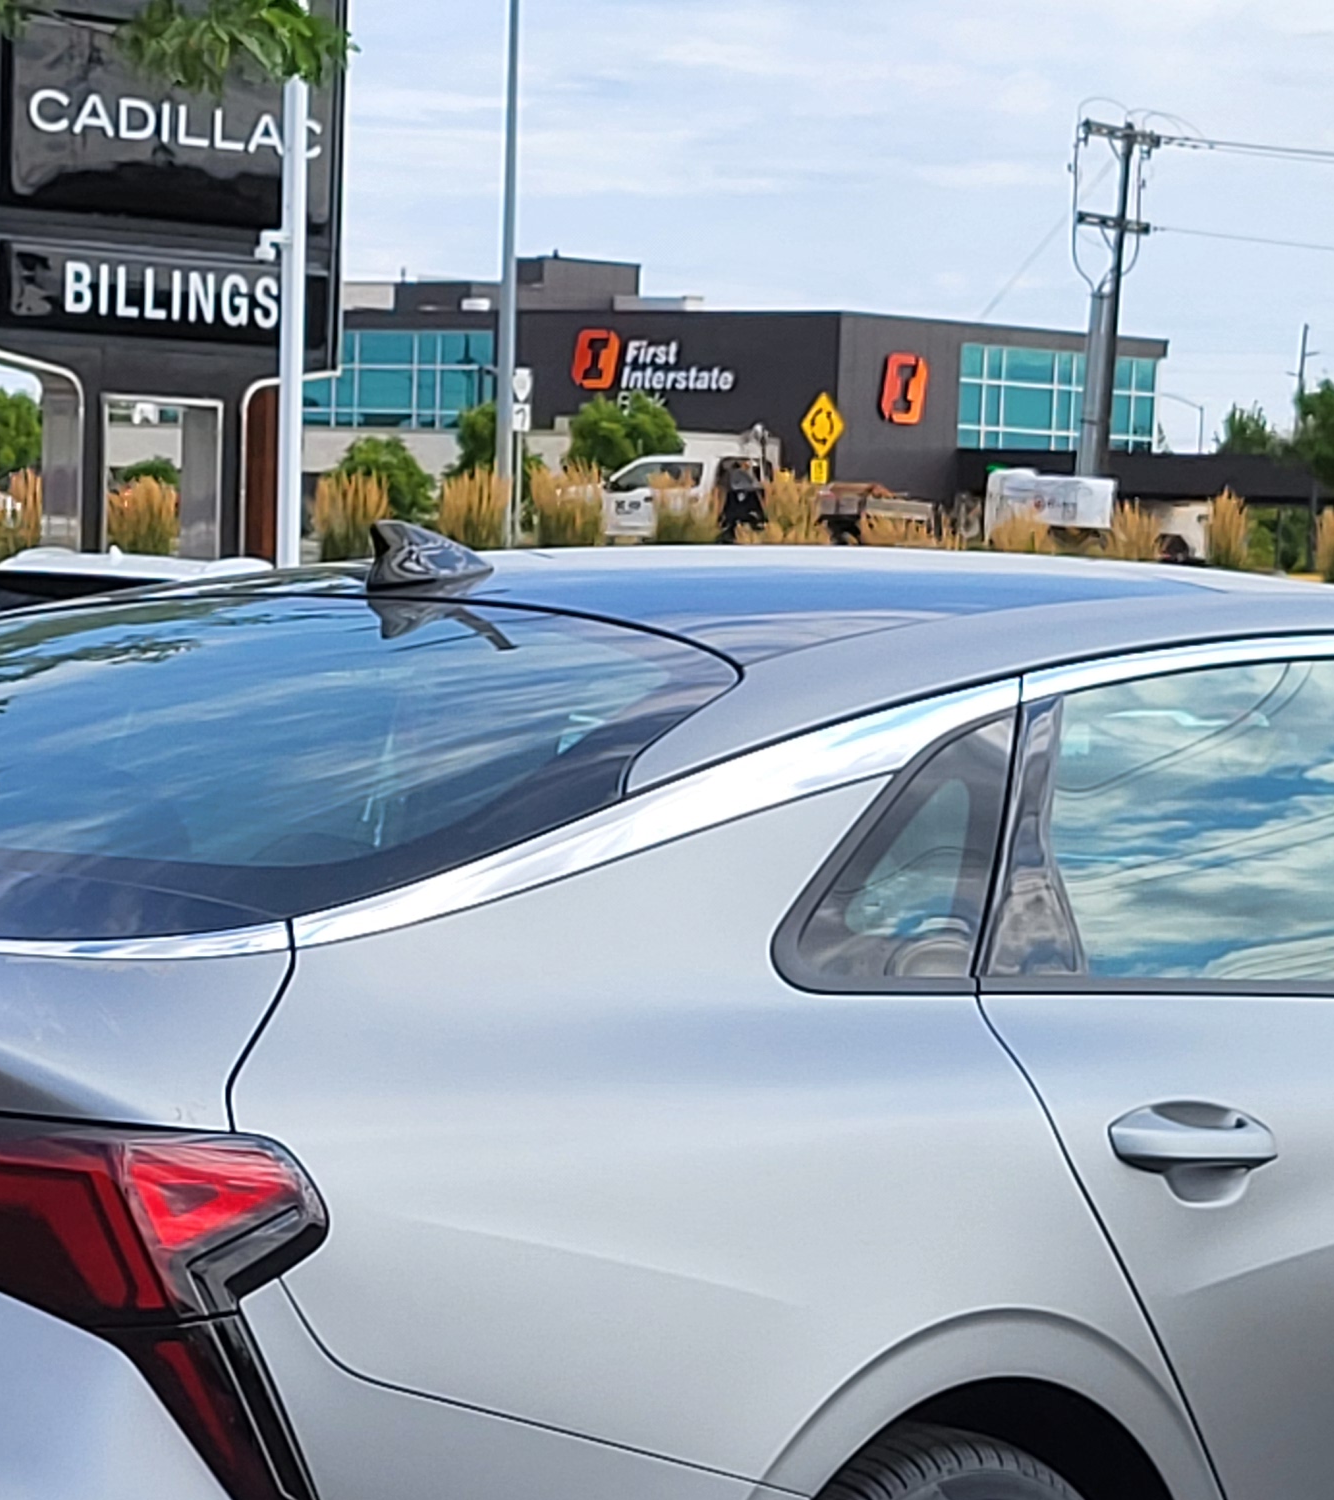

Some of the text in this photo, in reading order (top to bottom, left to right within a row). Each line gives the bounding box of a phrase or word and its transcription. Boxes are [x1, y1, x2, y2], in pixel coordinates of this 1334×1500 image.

[64, 261, 279, 329] BILLINGS
[624, 339, 678, 365] First
[620, 366, 735, 391] Interstate
